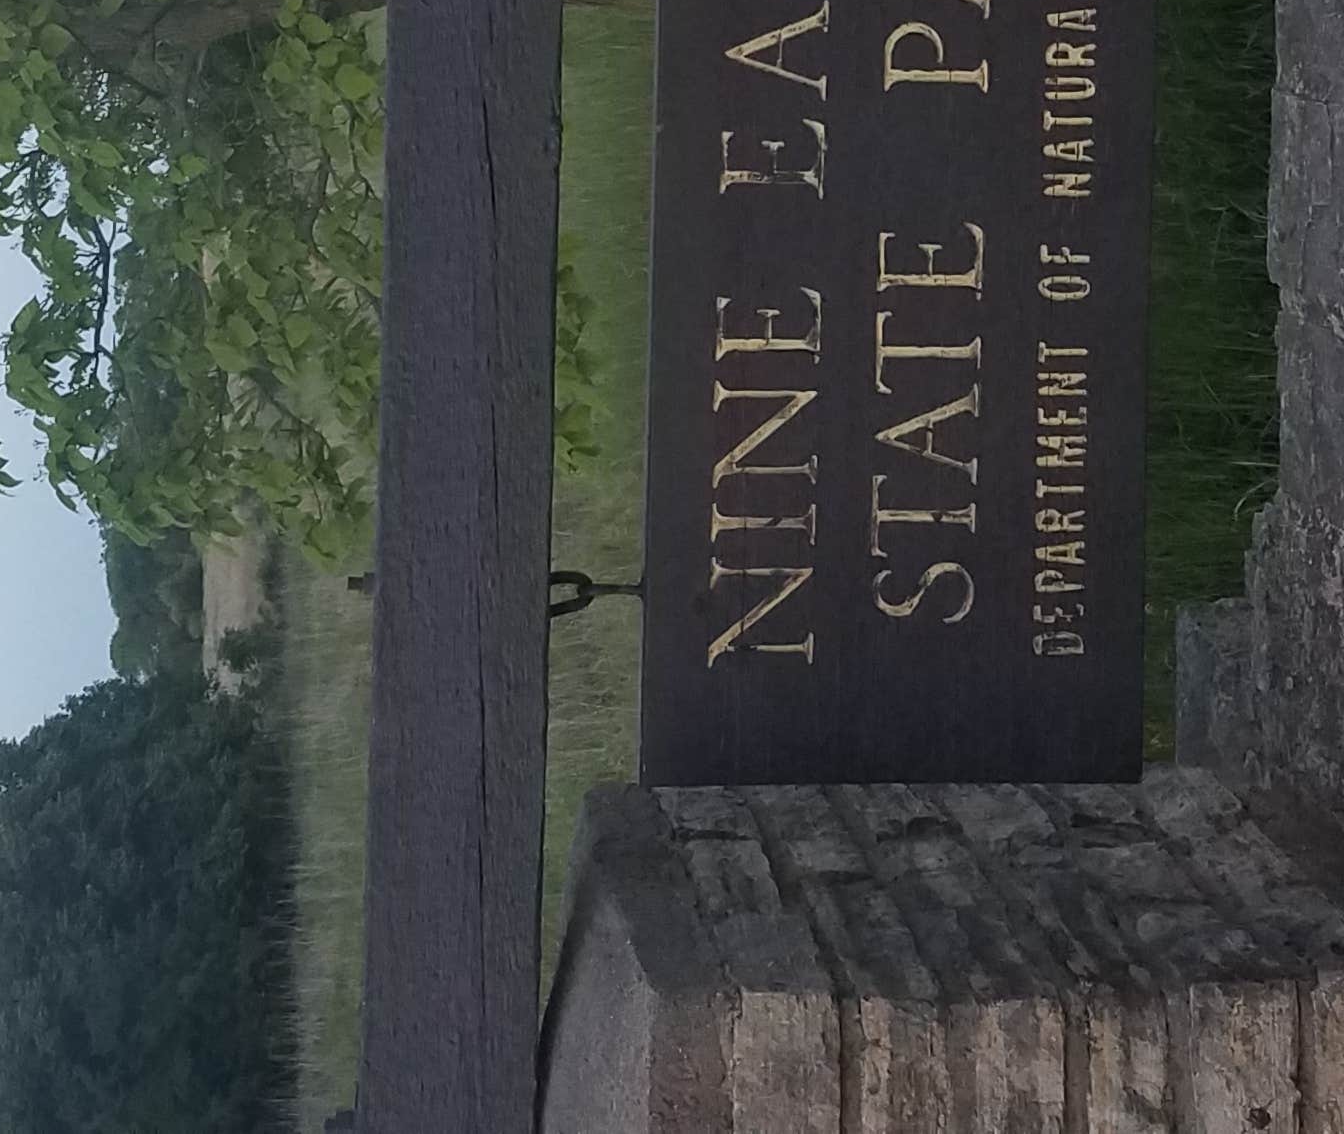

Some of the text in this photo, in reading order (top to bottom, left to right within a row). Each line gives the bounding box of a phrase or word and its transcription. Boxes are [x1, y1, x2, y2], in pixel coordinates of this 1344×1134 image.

[870, 222, 984, 624] STATE
[1037, 243, 1091, 301] OF
[707, 286, 822, 668] NINE
[1032, 341, 1088, 656] DEPARTMENT
